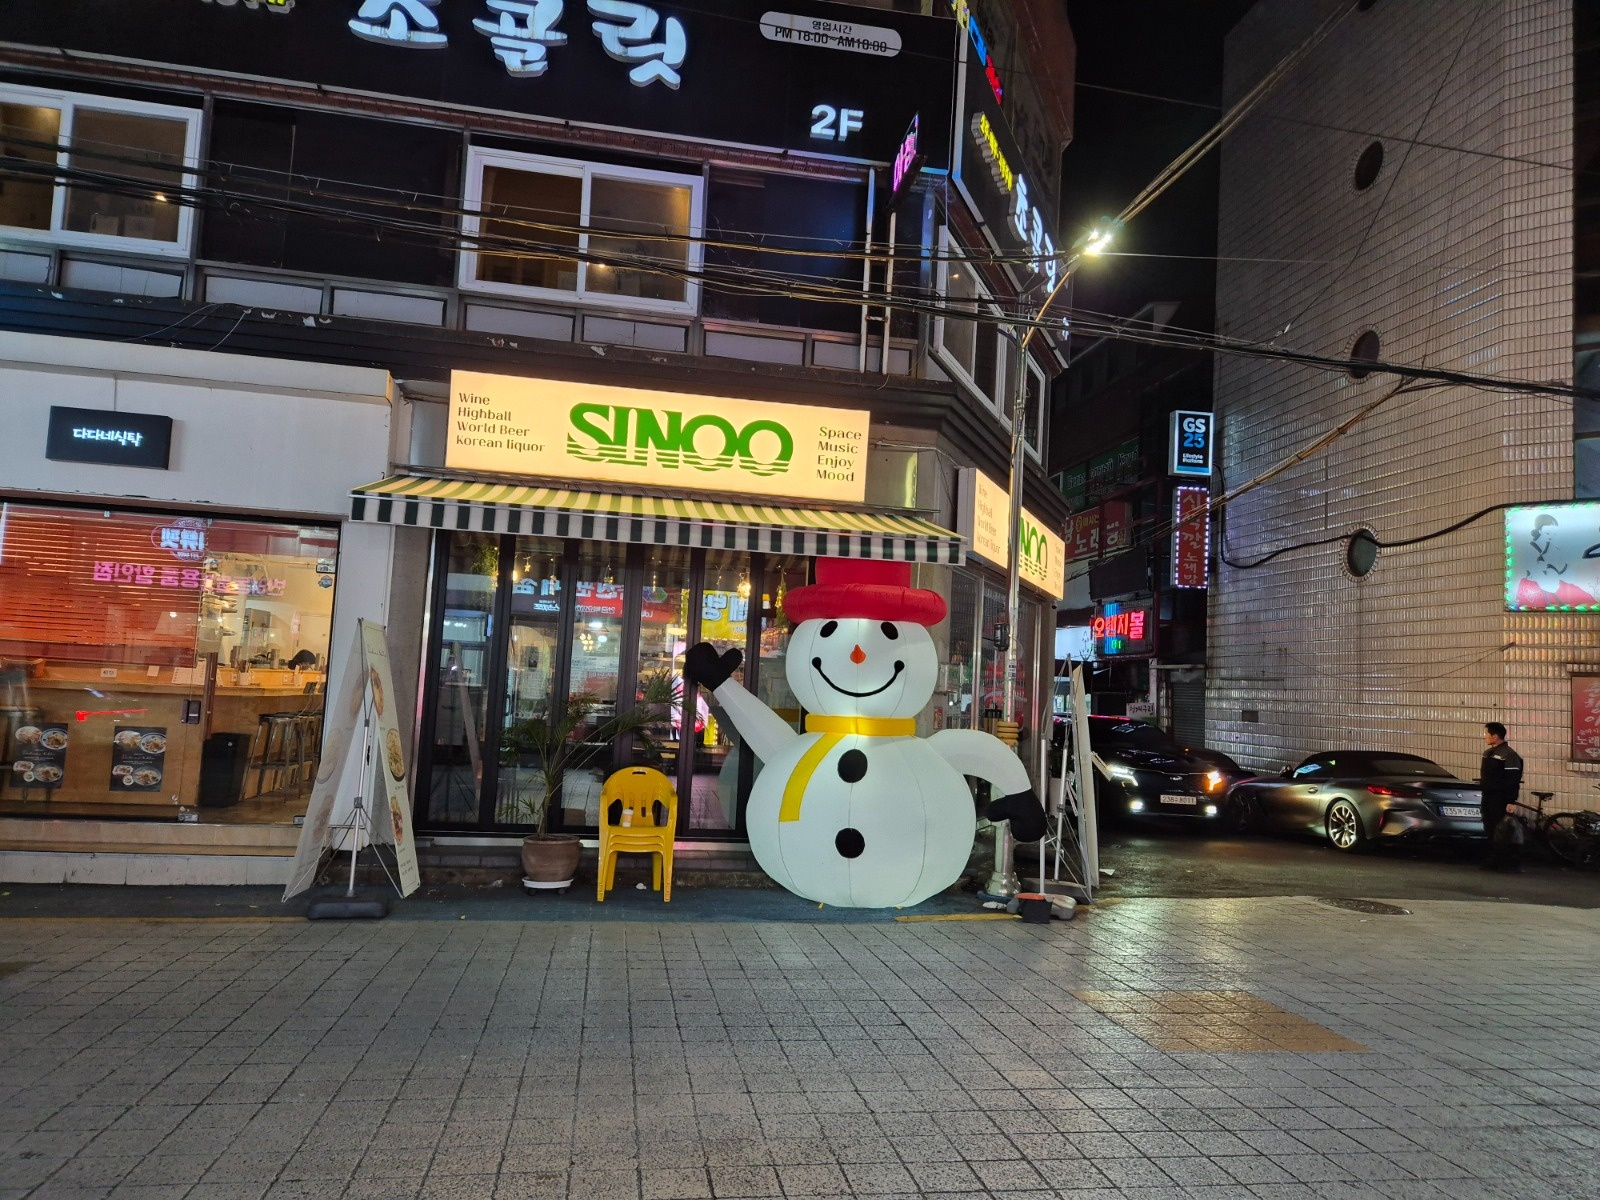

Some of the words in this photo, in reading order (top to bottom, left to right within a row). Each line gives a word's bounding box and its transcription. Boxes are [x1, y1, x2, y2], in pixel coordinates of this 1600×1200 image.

[774, 26, 792, 40] PM
[811, 20, 852, 35] 영업시간
[810, 104, 864, 141] 2F
[459, 393, 490, 406] Wine
[458, 407, 512, 421] Highball
[457, 421, 496, 434] World
[500, 425, 530, 437] Beer
[1183, 417, 1206, 433] GS
[72, 427, 144, 448] 다다네식탁
[567, 402, 794, 477] SINOO
[819, 426, 862, 440] Space
[1183, 433, 1205, 448] 25
[456, 435, 503, 448] Korean
[506, 439, 546, 453] liquor
[818, 441, 858, 454] Music
[817, 455, 854, 470] Enjoy
[816, 469, 854, 482] Mood
[1020, 517, 1048, 581] NOO
